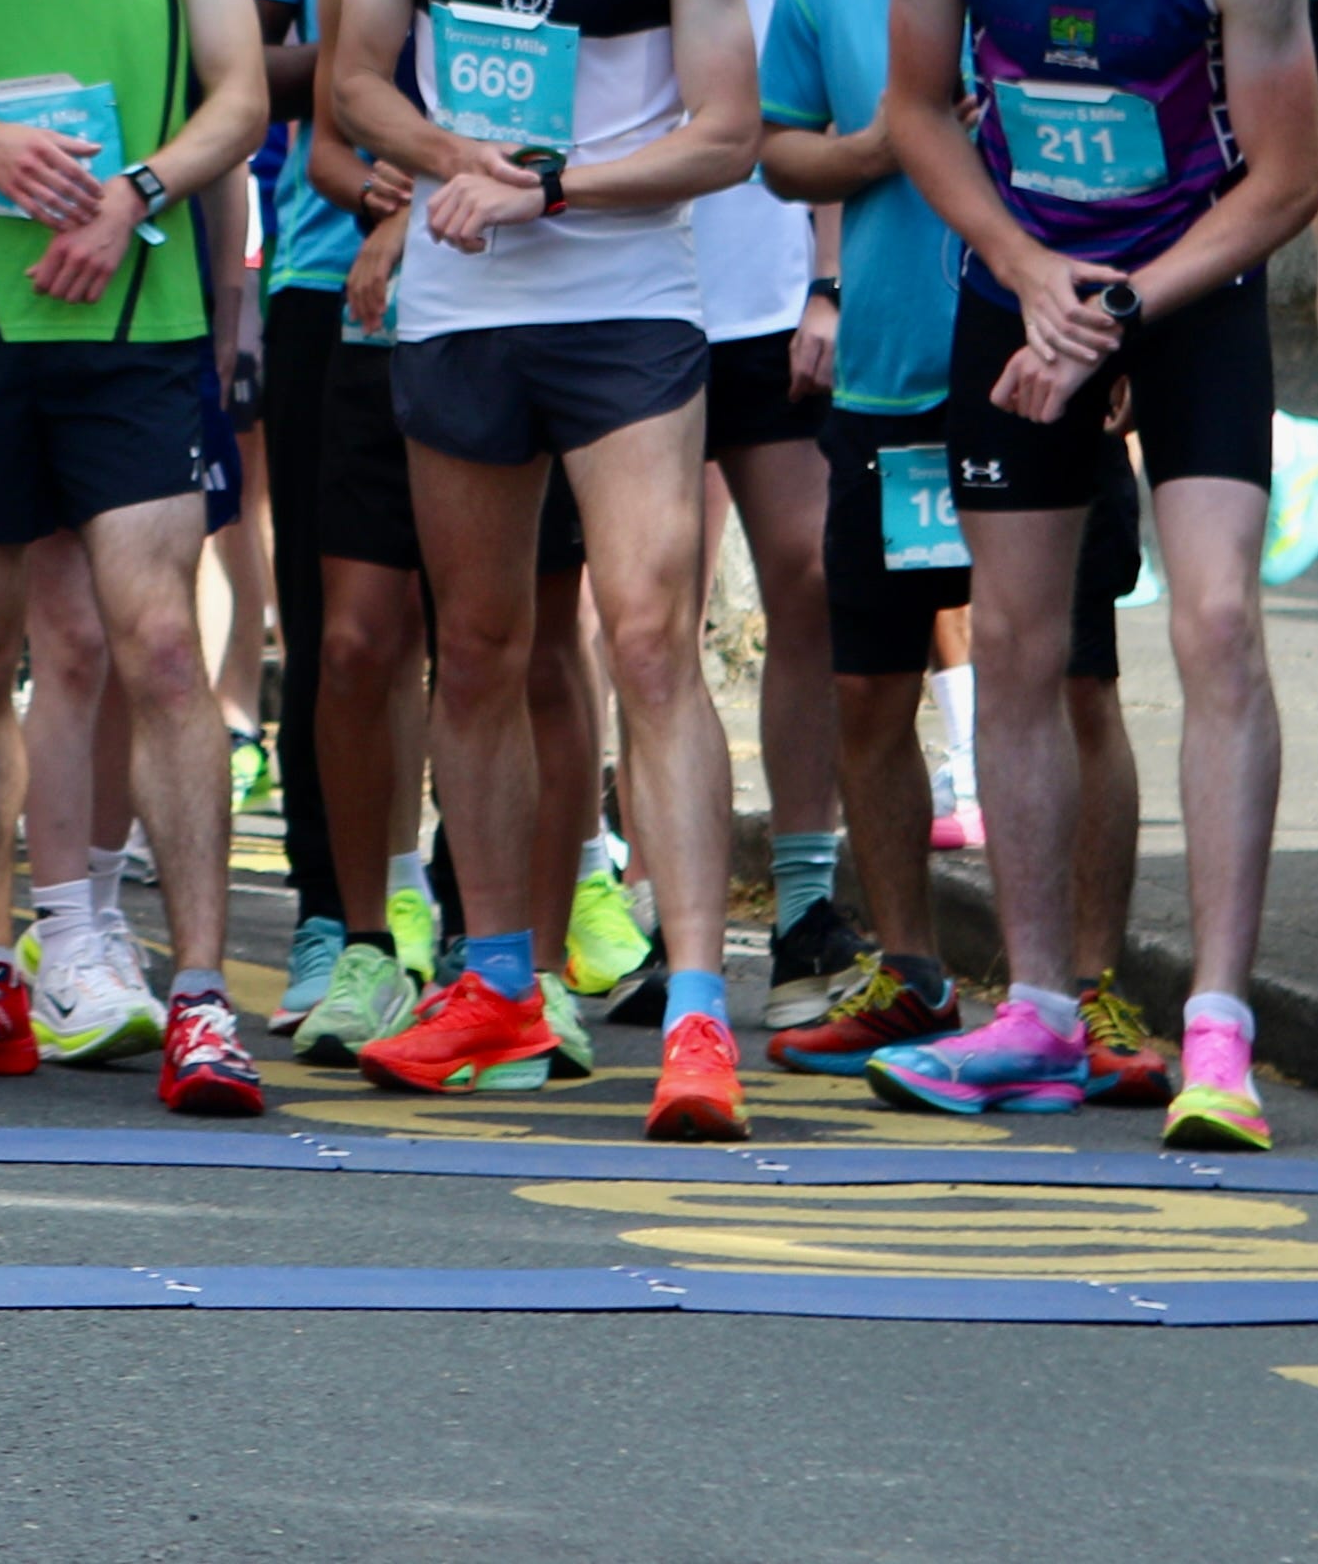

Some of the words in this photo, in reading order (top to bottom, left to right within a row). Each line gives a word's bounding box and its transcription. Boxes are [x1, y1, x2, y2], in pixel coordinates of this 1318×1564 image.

[501, 36, 512, 51] 5
[514, 38, 549, 57] Mile
[450, 51, 535, 102] 669
[1036, 123, 1115, 165] 211
